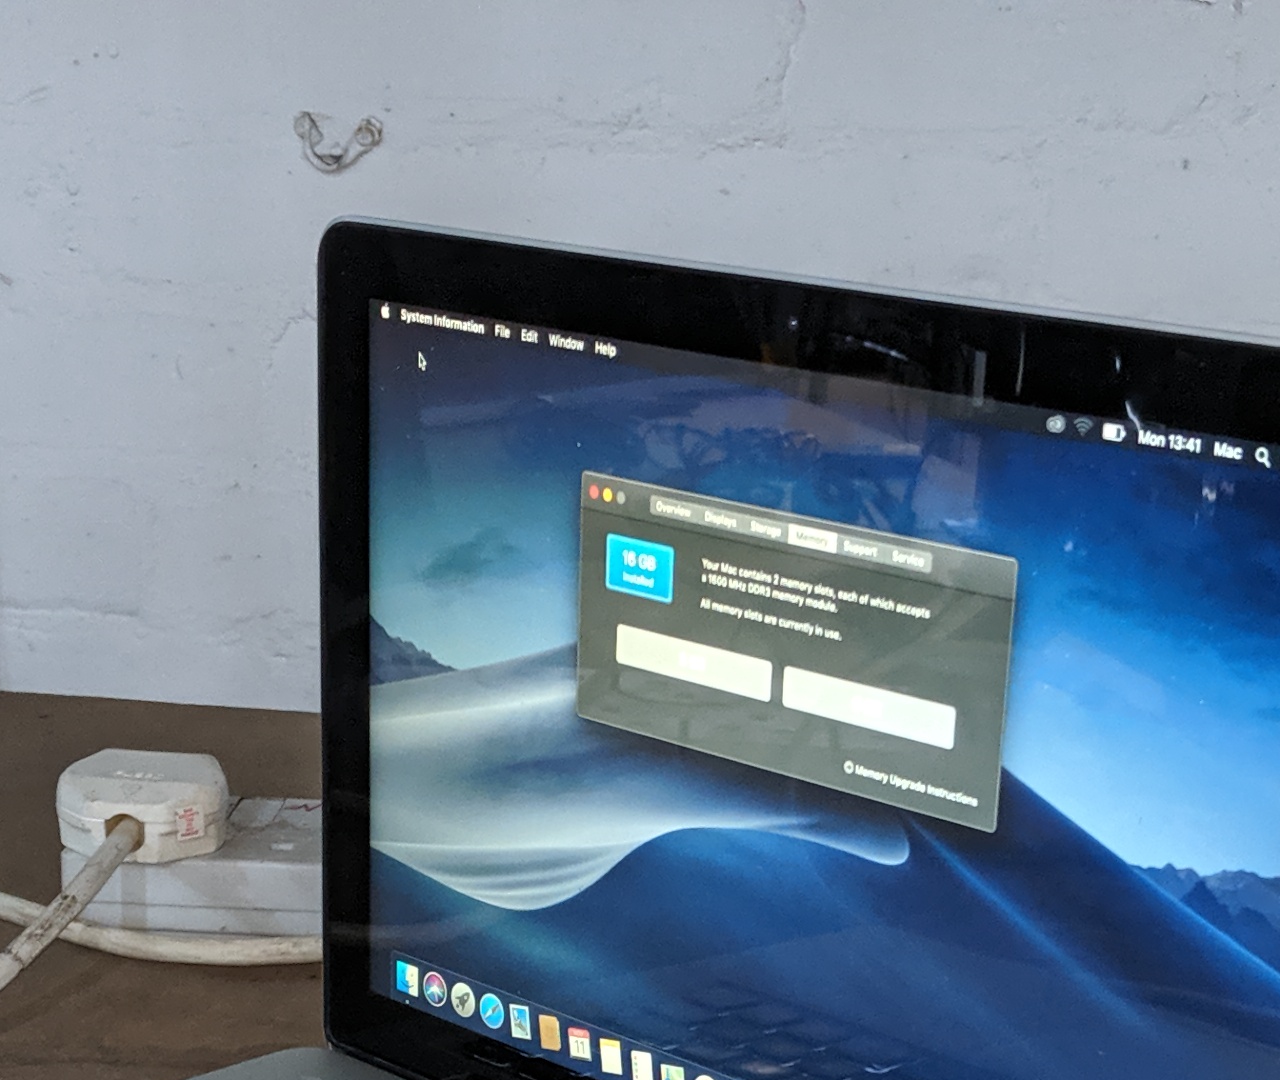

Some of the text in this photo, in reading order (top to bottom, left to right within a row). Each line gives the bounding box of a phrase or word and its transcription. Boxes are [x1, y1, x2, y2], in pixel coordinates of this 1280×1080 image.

[400, 308, 485, 334] System Information
[494, 323, 511, 339] File
[520, 328, 539, 344] Edit
[548, 333, 585, 352] Window
[594, 340, 617, 359] Help
[1137, 429, 1202, 454] Mon 13:41
[1213, 441, 1244, 460] Mac
[656, 500, 691, 518] Overview
[704, 510, 737, 529] Displays
[750, 520, 782, 538] Storage
[843, 540, 878, 558] Support
[638, 553, 658, 572] GB
[892, 550, 925, 568] Service
[701, 558, 720, 572] Your
[720, 562, 738, 576] Mac
[738, 567, 772, 584] contains
[773, 573, 780, 586] 2
[780, 577, 813, 595] memory
[837, 590, 858, 603] each
[858, 593, 870, 606] of
[870, 596, 895, 612] which
[896, 602, 931, 620] accepts
[728, 578, 747, 593] MHz
[747, 582, 771, 598] DDR3
[771, 589, 804, 608] memory
[700, 597, 843, 642] All memory slots are currently in use.
[855, 764, 979, 808] Memory Upgrade Instructions
[575, 1039, 586, 1055] 11
